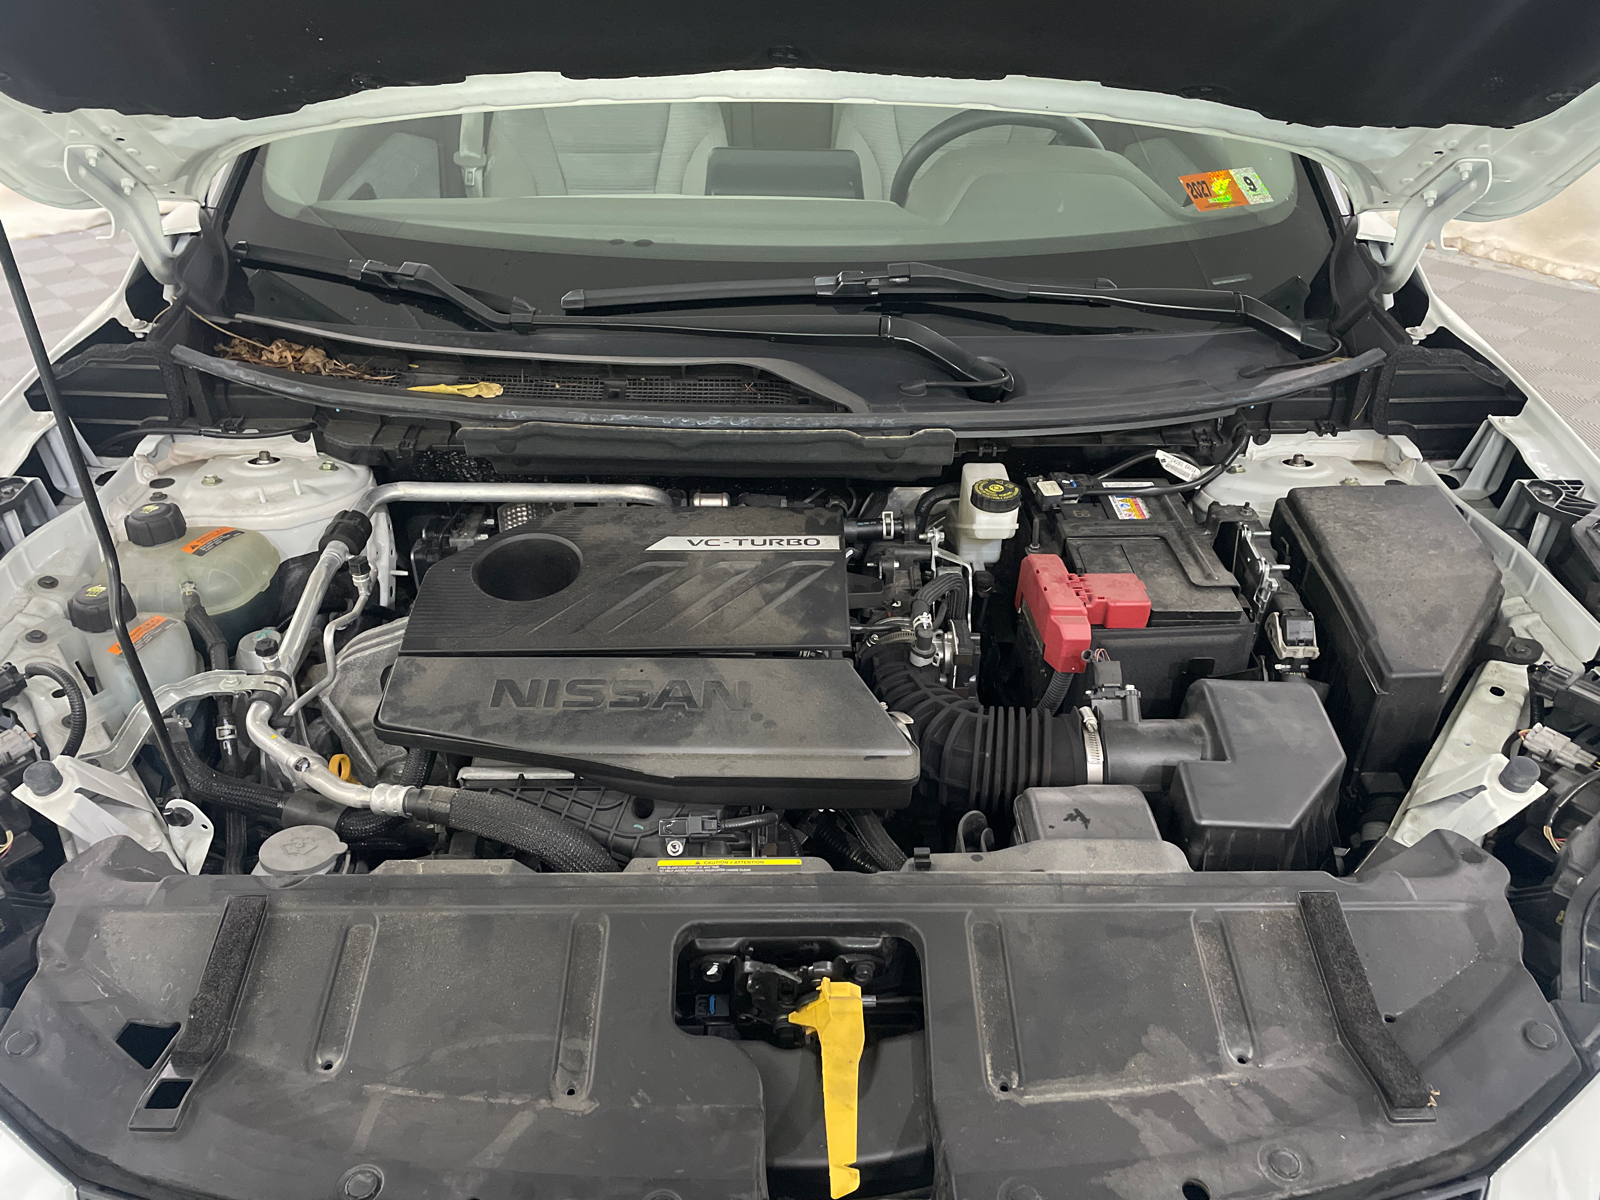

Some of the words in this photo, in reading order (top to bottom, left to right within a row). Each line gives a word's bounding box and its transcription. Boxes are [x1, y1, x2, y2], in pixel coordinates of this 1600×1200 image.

[1185, 180, 1212, 199] 2027
[1243, 175, 1257, 192] 9
[686, 537, 821, 547] VC-TURBO
[489, 678, 750, 710] NISSAN
